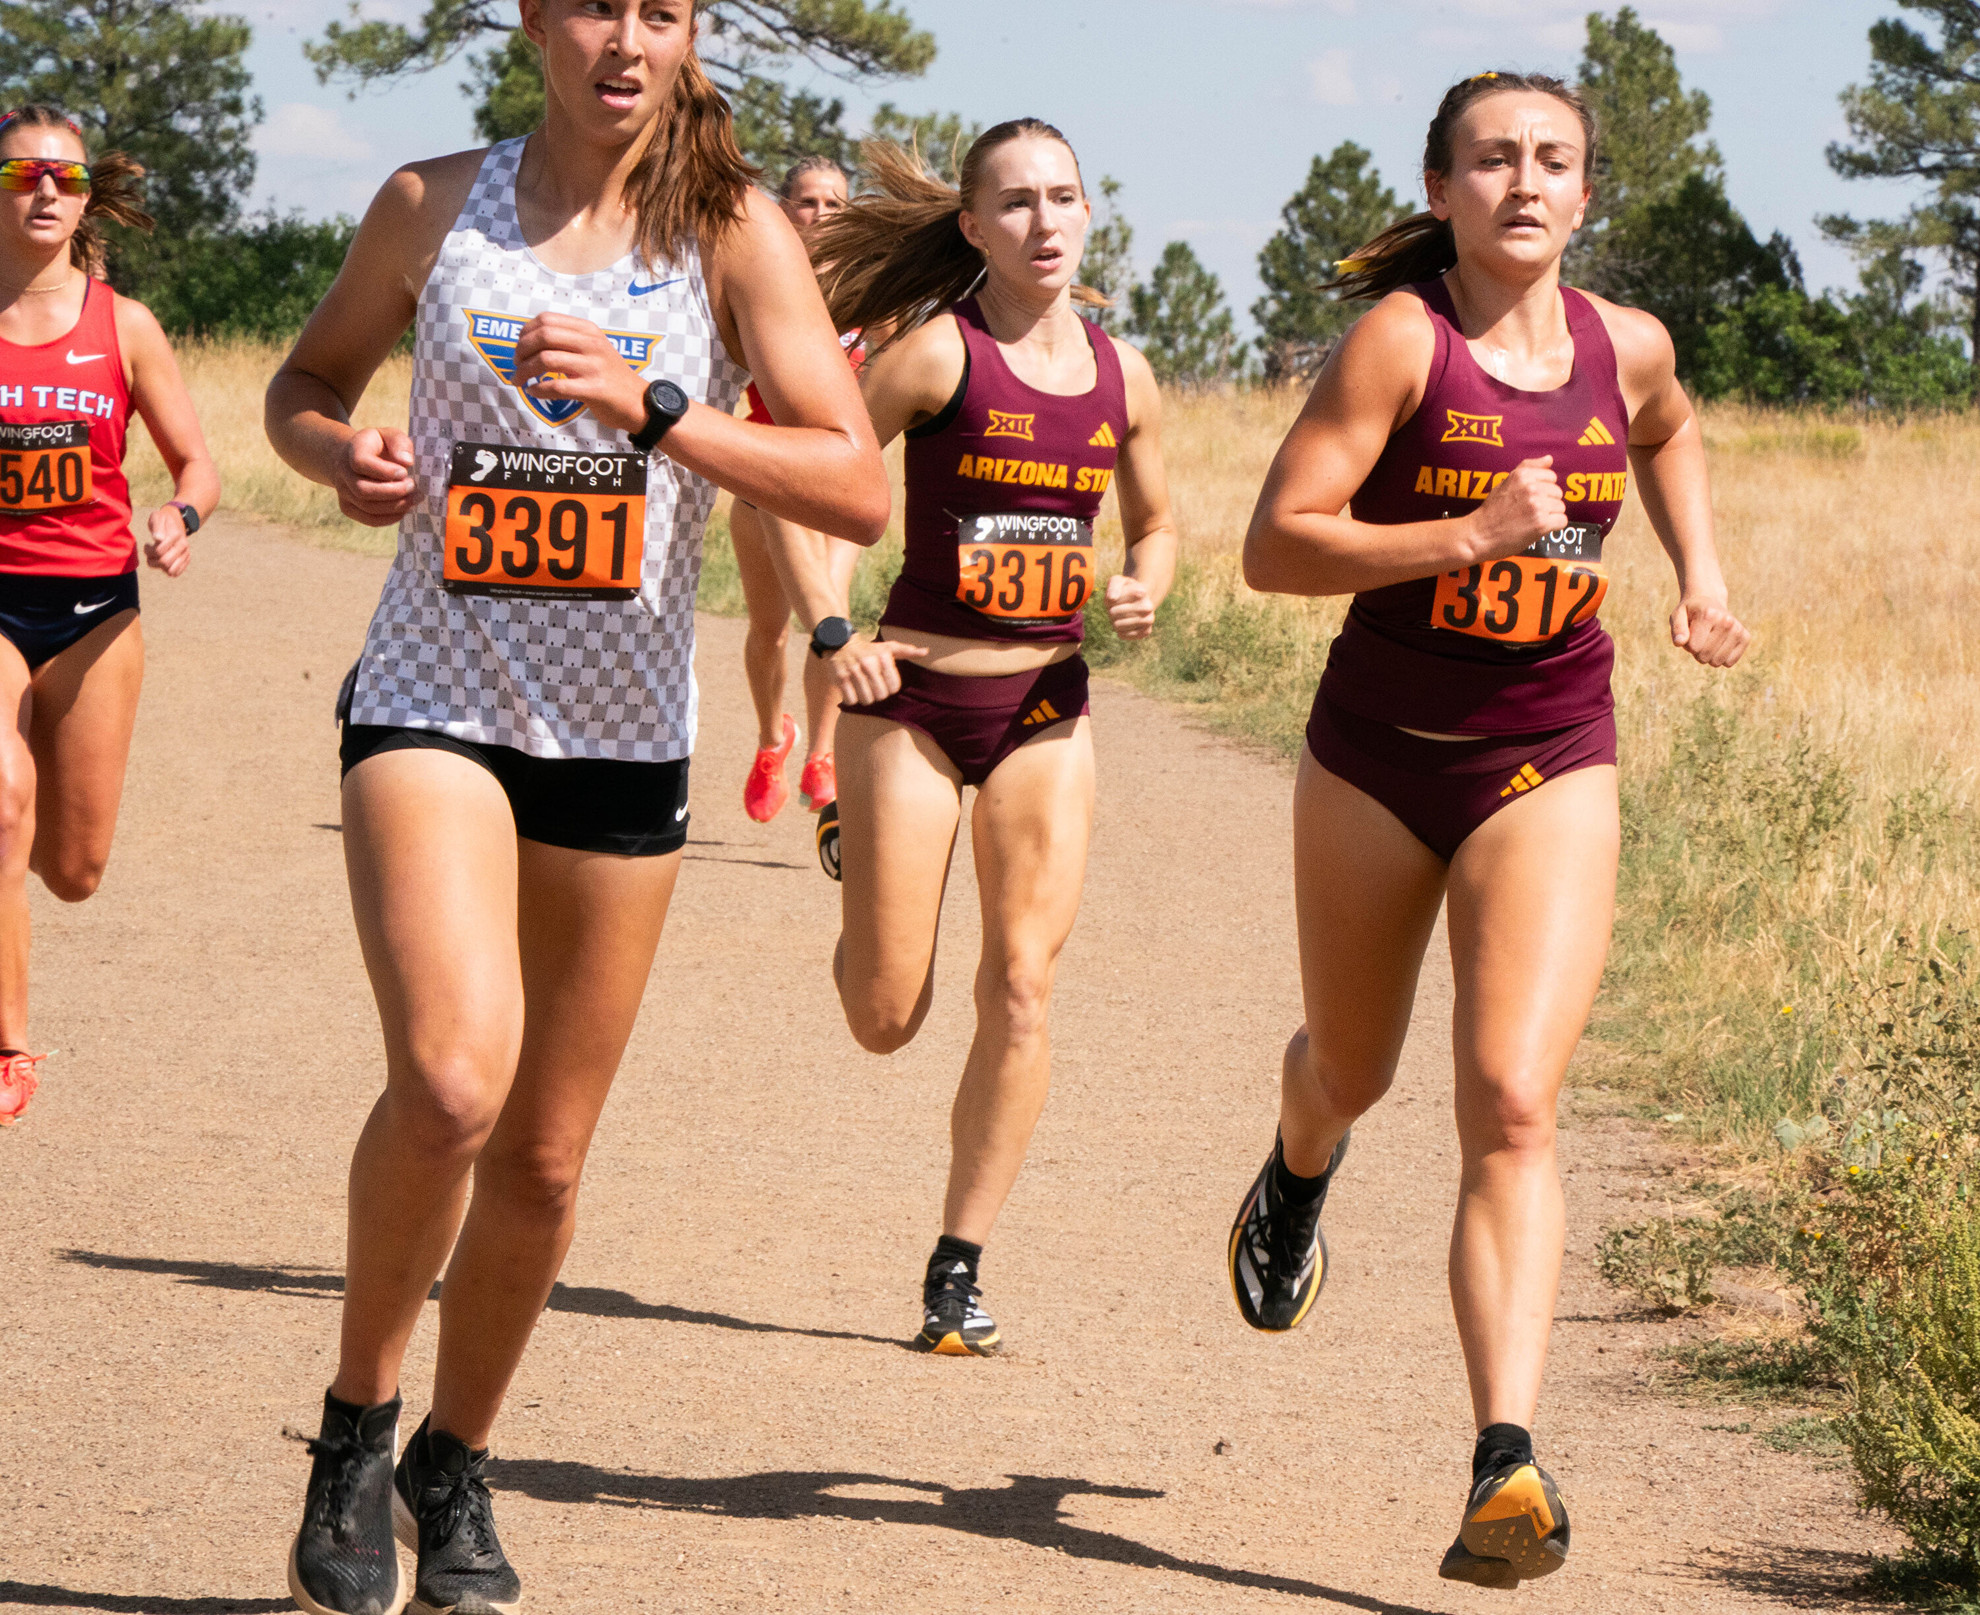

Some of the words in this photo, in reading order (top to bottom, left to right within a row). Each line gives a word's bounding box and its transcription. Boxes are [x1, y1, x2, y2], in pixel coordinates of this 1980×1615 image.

[32, 385, 114, 419] TECH
[8, 437, 73, 446] INISH
[502, 451, 627, 478] WINGFOOT
[957, 453, 1068, 489] ARIZONA
[1074, 466, 1111, 492] STA
[504, 472, 622, 487] FINISH
[1564, 471, 1627, 502] STATE
[455, 492, 628, 581] 3391
[996, 515, 1077, 532] WINGFOOT
[999, 529, 1077, 541] FINISH
[1528, 542, 1582, 555] NISH
[965, 549, 1087, 612] 3316
[1443, 561, 1599, 635] 3312
